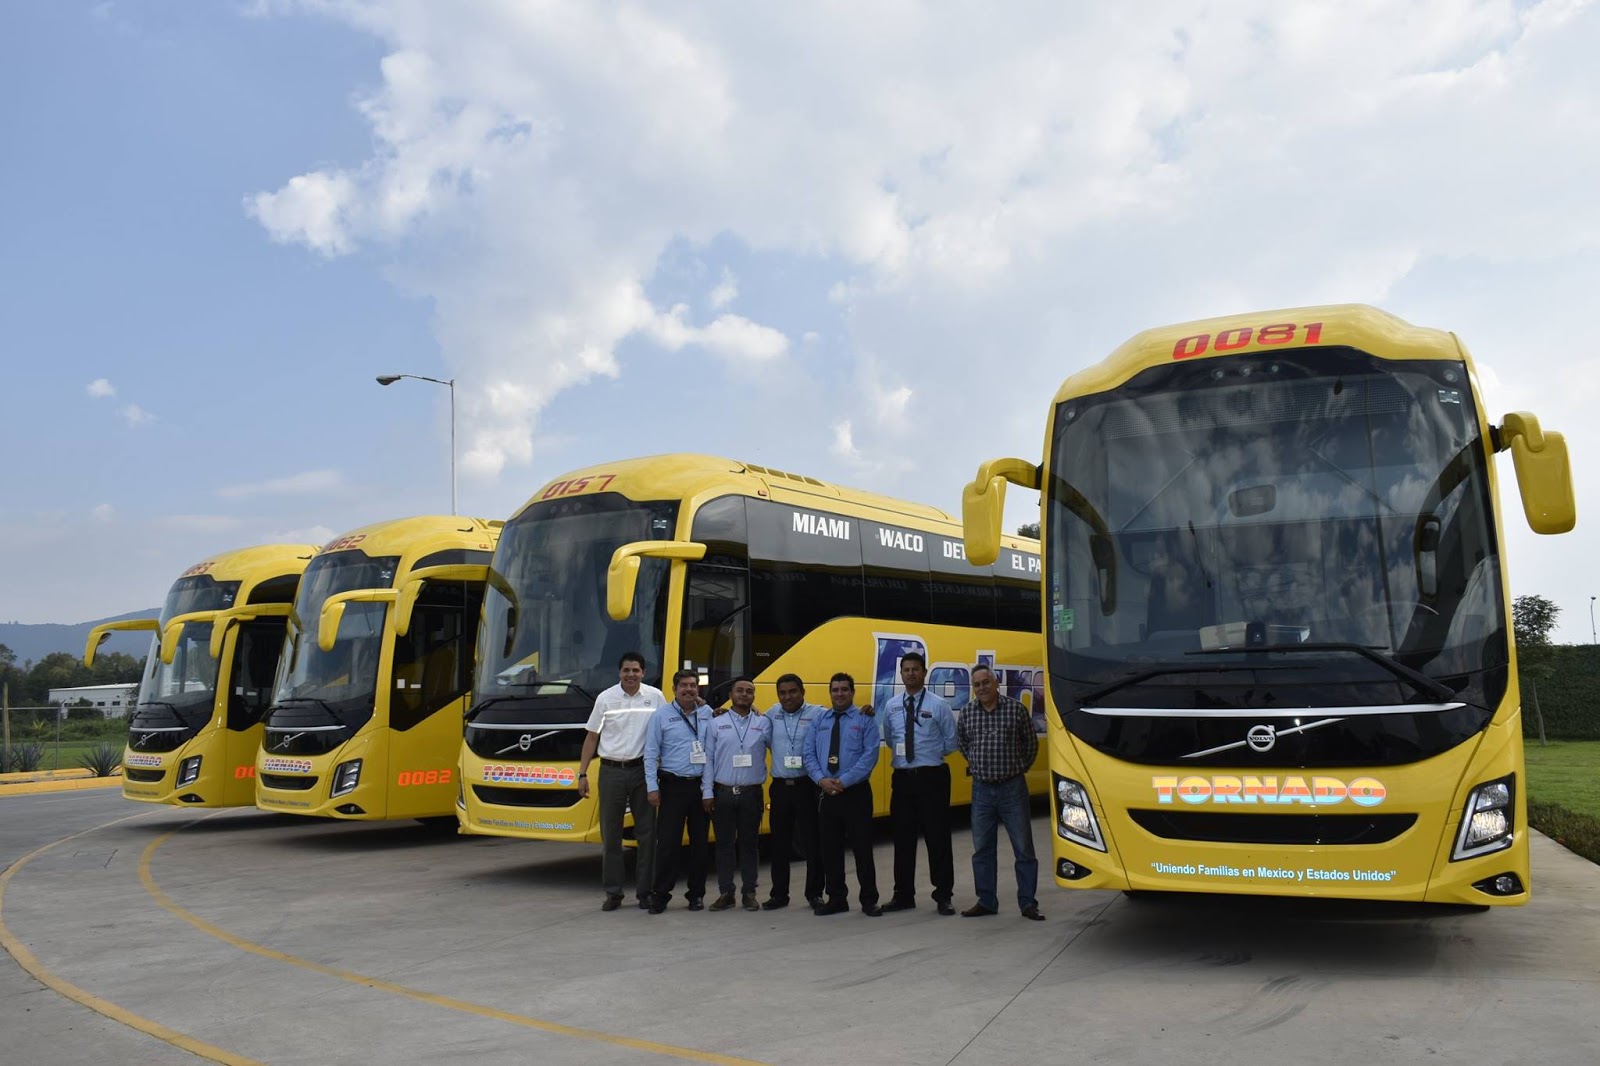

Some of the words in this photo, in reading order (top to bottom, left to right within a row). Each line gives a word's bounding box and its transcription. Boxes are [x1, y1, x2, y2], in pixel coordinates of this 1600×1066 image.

[1172, 322, 1323, 360] 0081
[542, 474, 617, 500] 0157
[793, 512, 850, 540] MIAMI
[879, 528, 924, 553] WACO
[943, 540, 968, 560] DET
[1012, 553, 1026, 571] EL
[1028, 556, 1042, 574] PA
[398, 769, 451, 786] 0082
[483, 765, 575, 786] TORNADO
[1152, 775, 1387, 807] TORNADO
[1198, 864, 1240, 877] Familias
[1242, 868, 1255, 877] en
[1257, 866, 1295, 879] Mexico
[1297, 870, 1304, 881] y
[1306, 868, 1350, 880] Estados
